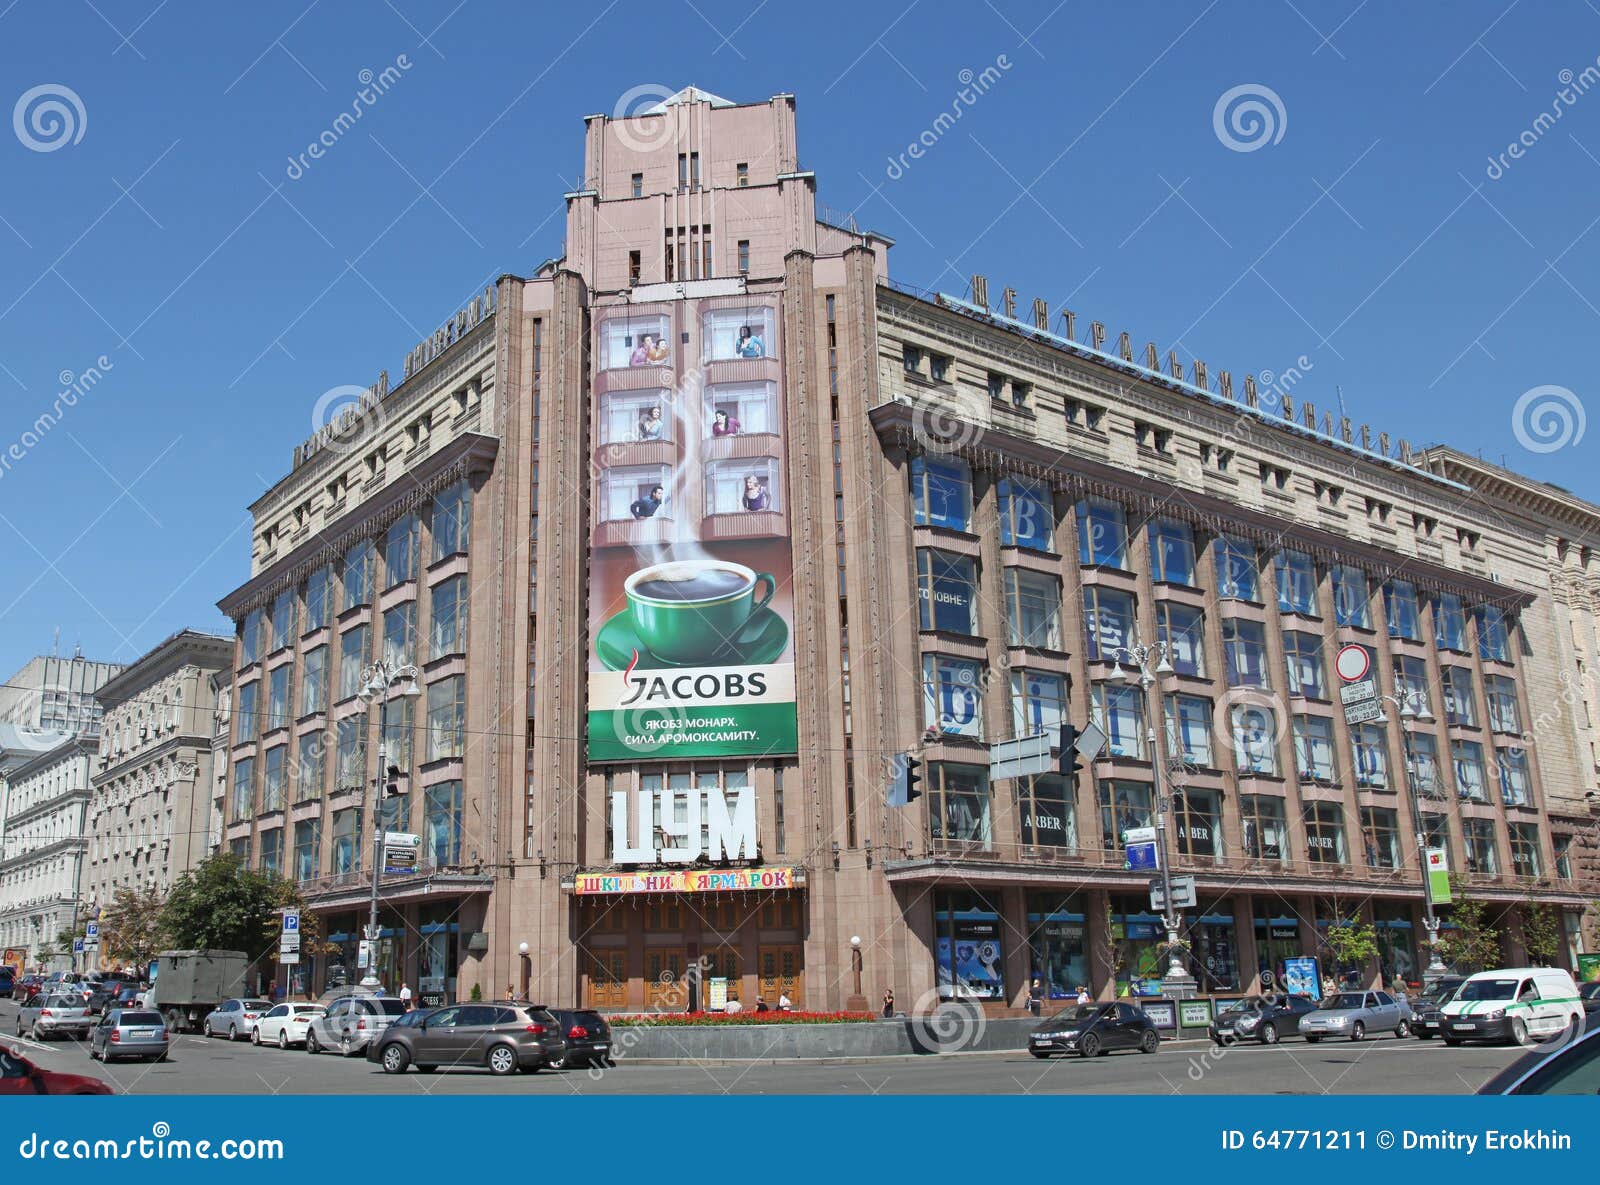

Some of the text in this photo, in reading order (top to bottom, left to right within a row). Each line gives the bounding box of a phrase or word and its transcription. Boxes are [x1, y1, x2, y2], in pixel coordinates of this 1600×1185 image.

[403, 284, 494, 379] УНІВЕРМА
[970, 274, 1259, 409] ЦЕНТРАЛЬНИЙ
[620, 672, 767, 706] JACOBS
[645, 717, 739, 730] ЯКОБЗ МОНАРХ.
[624, 734, 655, 745] СИЛА
[612, 787, 758, 863] ЦУМ
[1178, 824, 1209, 840] ABER
[583, 870, 787, 893] ШКІЛЬНИЙ ЯРМАРОК
